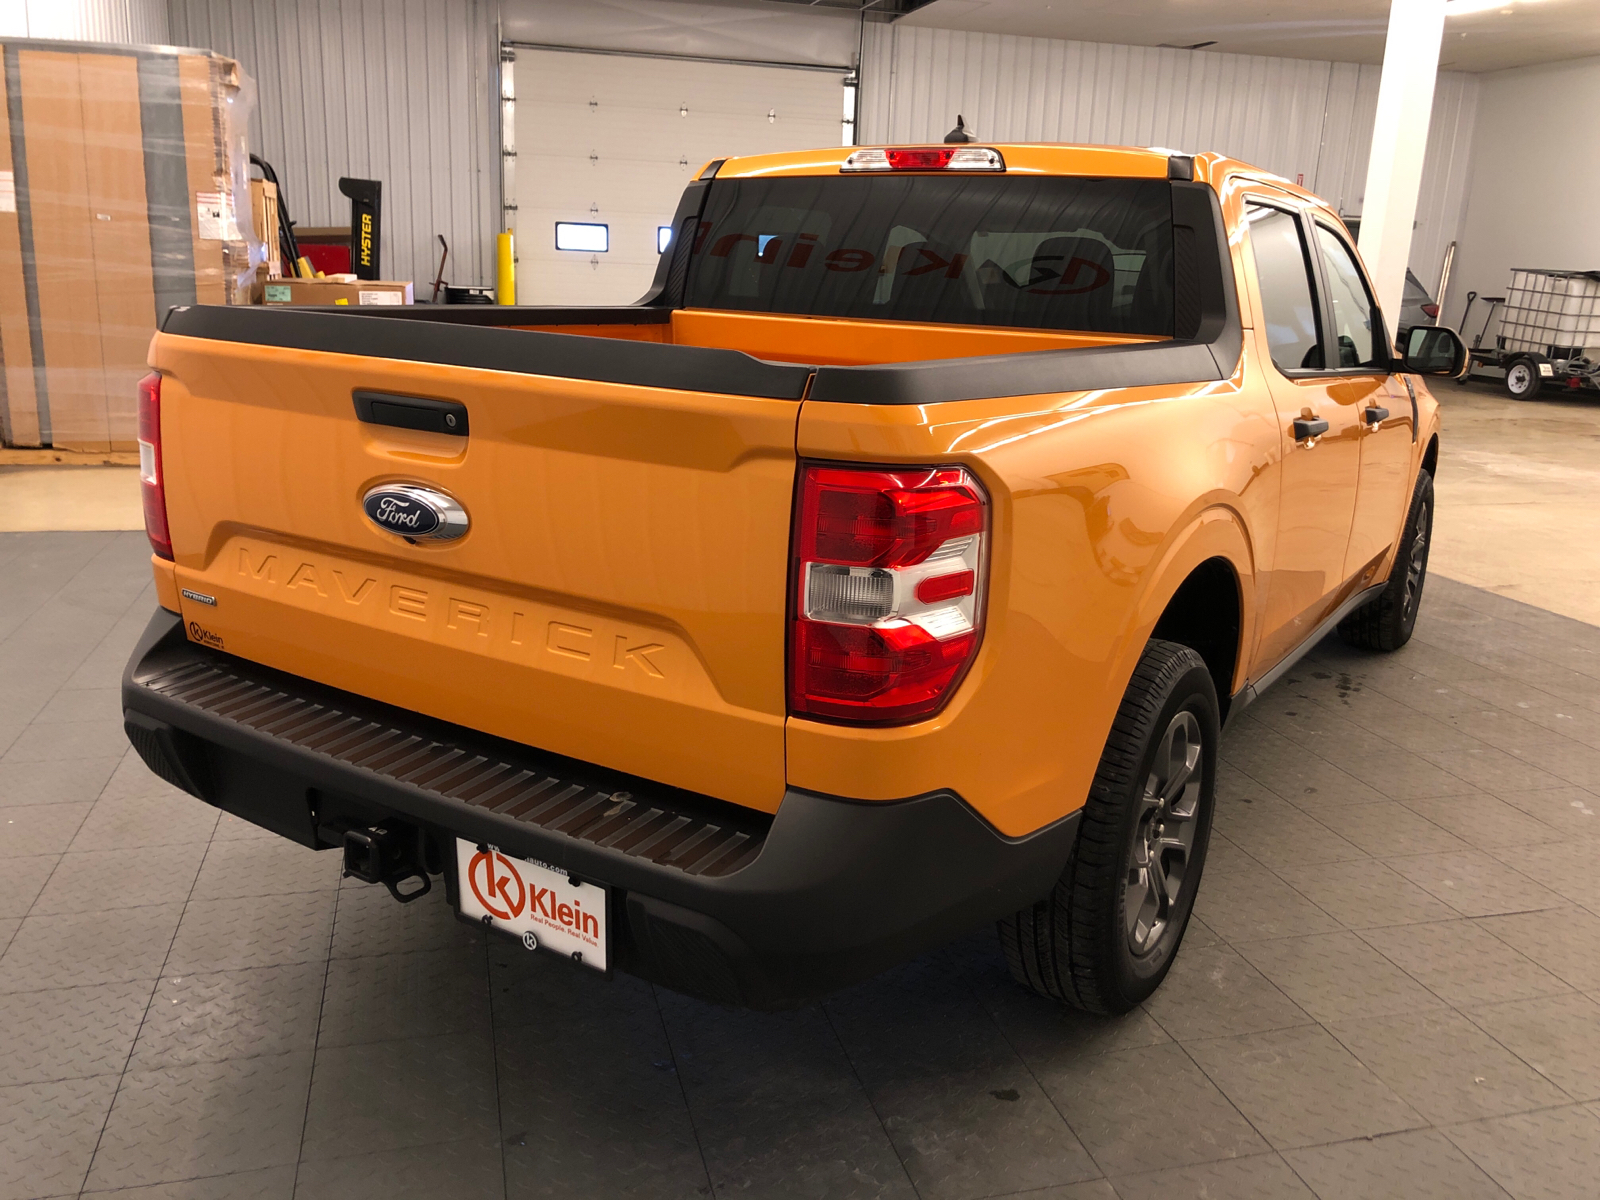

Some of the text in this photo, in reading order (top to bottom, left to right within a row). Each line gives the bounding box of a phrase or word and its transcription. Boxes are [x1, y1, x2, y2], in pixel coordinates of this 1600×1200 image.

[361, 213, 372, 267] HYSTER
[376, 497, 421, 528] Ford
[183, 590, 212, 604] HYBRID
[238, 548, 666, 679] MAVERICK
[203, 629, 224, 645] Klein
[529, 883, 599, 939] Klein
[530, 914, 544, 924] Real
[544, 919, 567, 933] People.
[567, 928, 581, 939] Real
